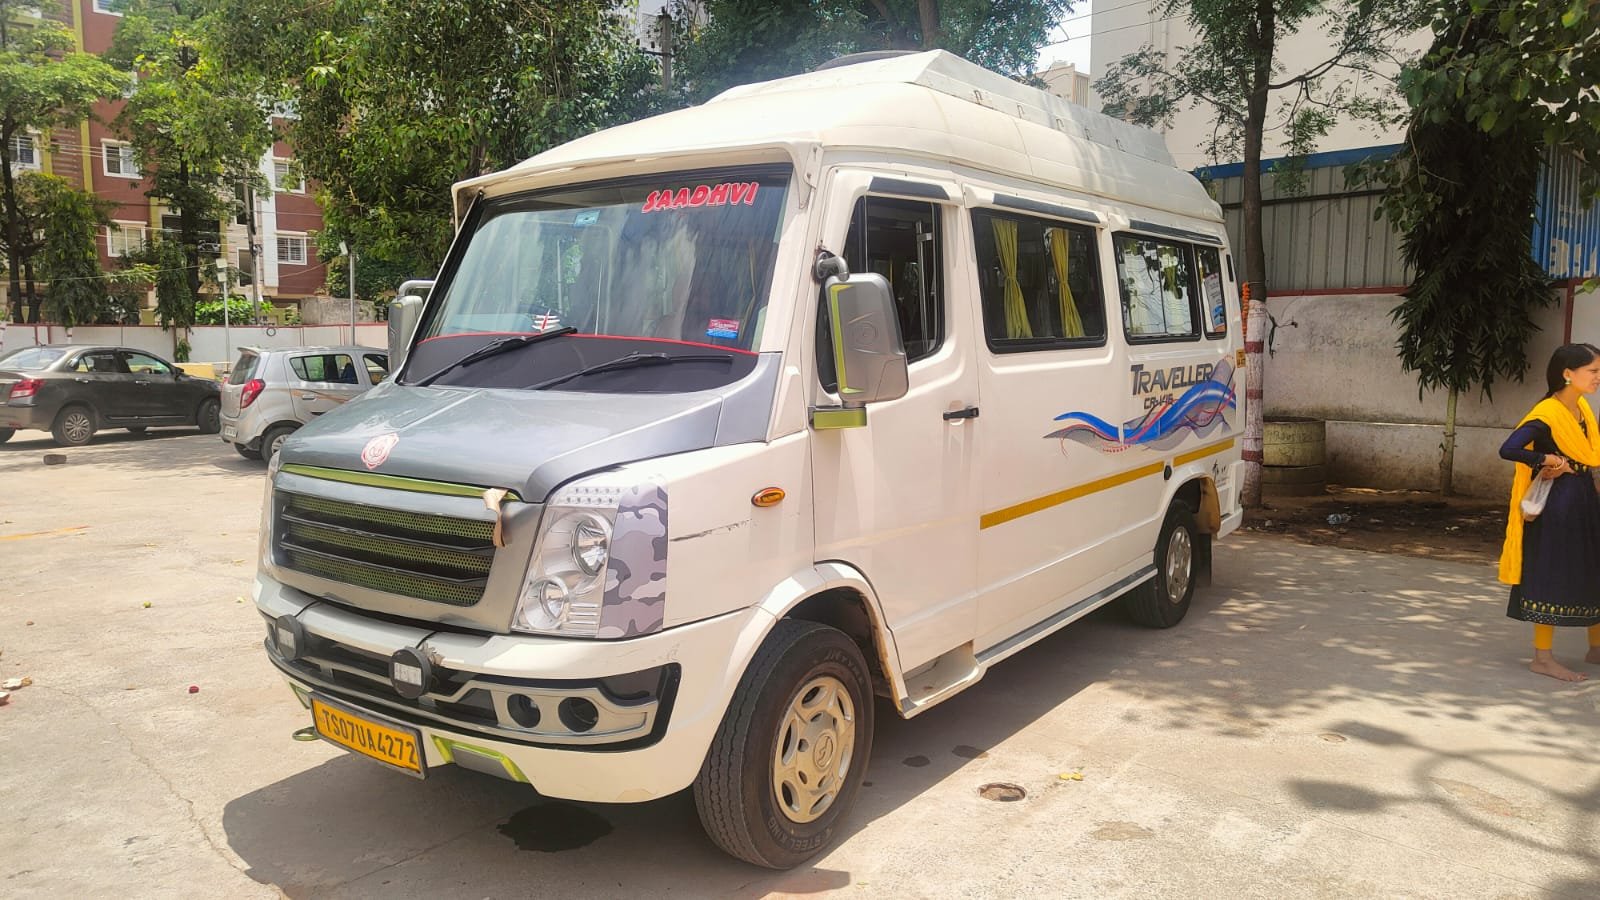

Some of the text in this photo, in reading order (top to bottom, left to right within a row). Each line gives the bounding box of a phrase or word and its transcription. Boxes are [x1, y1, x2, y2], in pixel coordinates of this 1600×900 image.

[641, 182, 759, 213] SAADHVI
[1130, 363, 1213, 395] TRAVELLER
[322, 709, 417, 765] TS07UA4272
